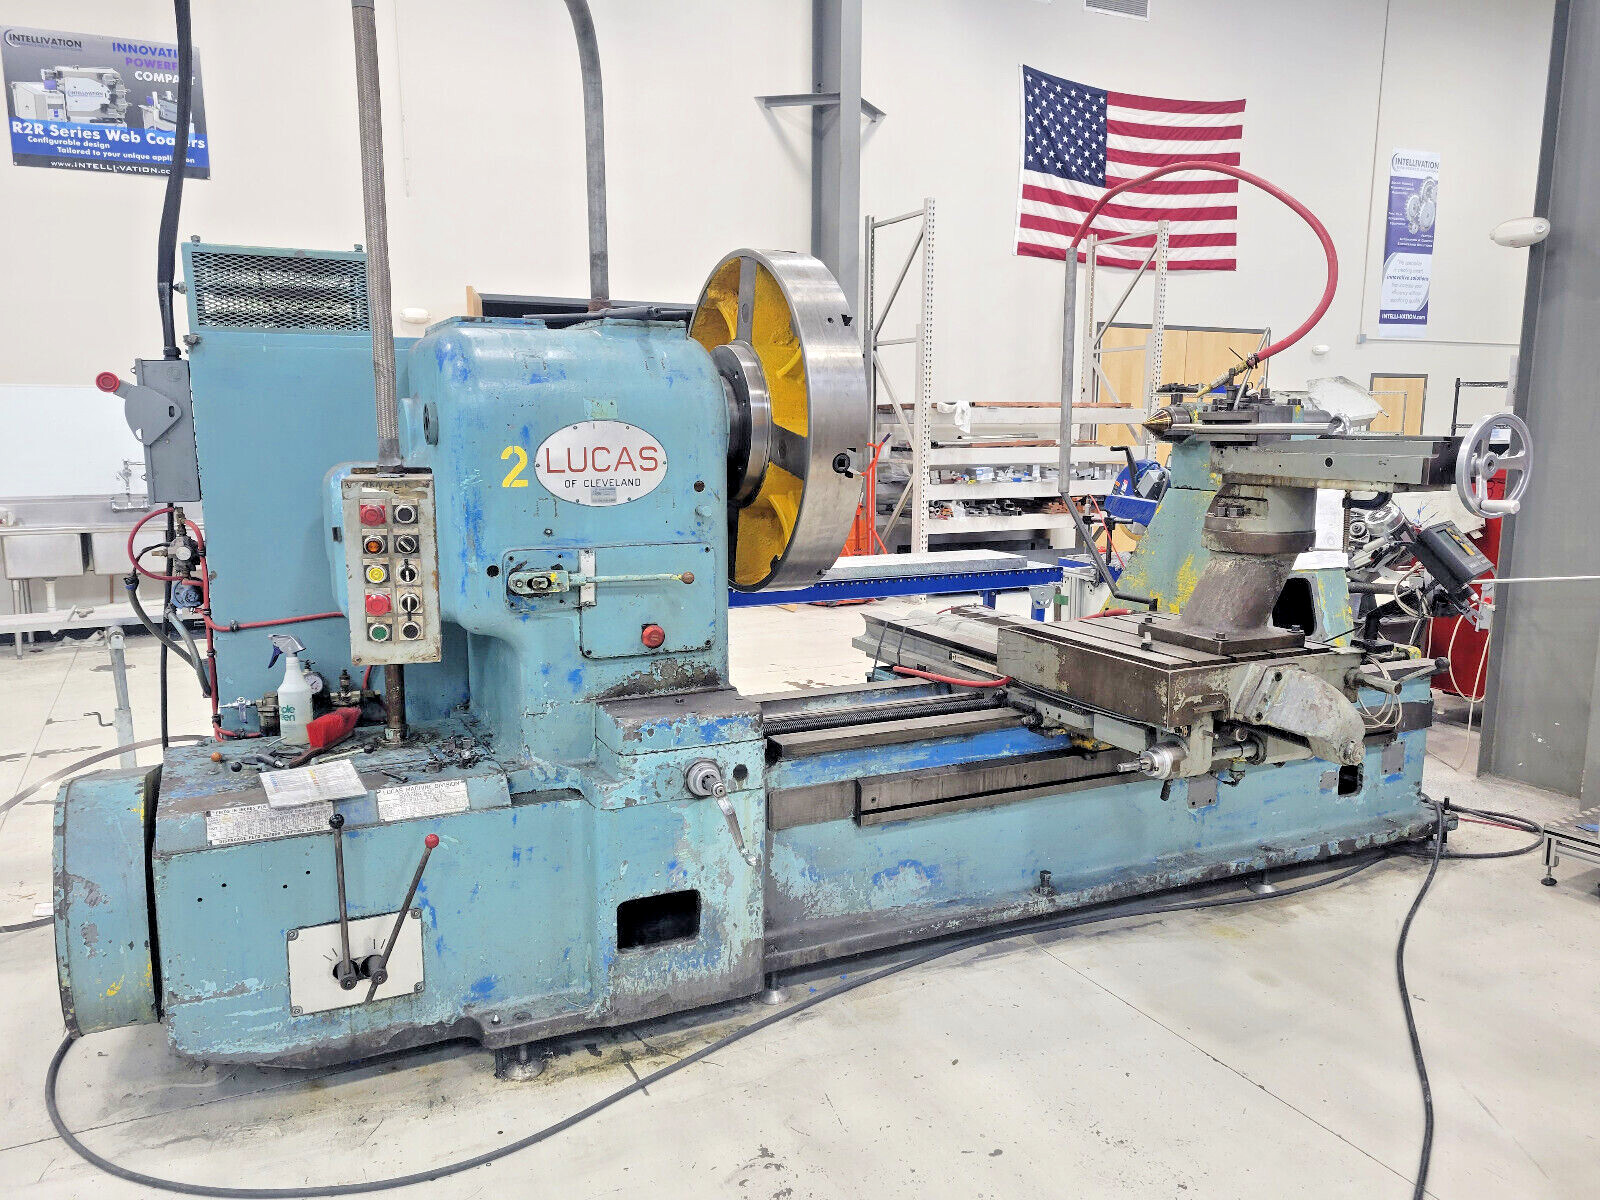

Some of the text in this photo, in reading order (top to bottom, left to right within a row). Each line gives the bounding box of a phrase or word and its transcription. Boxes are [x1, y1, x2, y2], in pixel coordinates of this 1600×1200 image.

[9, 33, 82, 48] INTELLIVATION
[112, 42, 178, 58] INNOVATI
[125, 57, 178, 71] POWERF
[134, 70, 195, 86] COMPAT
[12, 121, 206, 149] R2R Series Web Coars
[27, 135, 110, 149] Configurable design
[57, 146, 91, 156] Tailored
[123, 152, 150, 161] unique
[152, 153, 195, 163] applion
[1395, 157, 1440, 169] INTELLIVATION
[501, 445, 528, 488] 2
[546, 446, 658, 474] LUCAS
[564, 478, 641, 489] OF CLEVELAND
